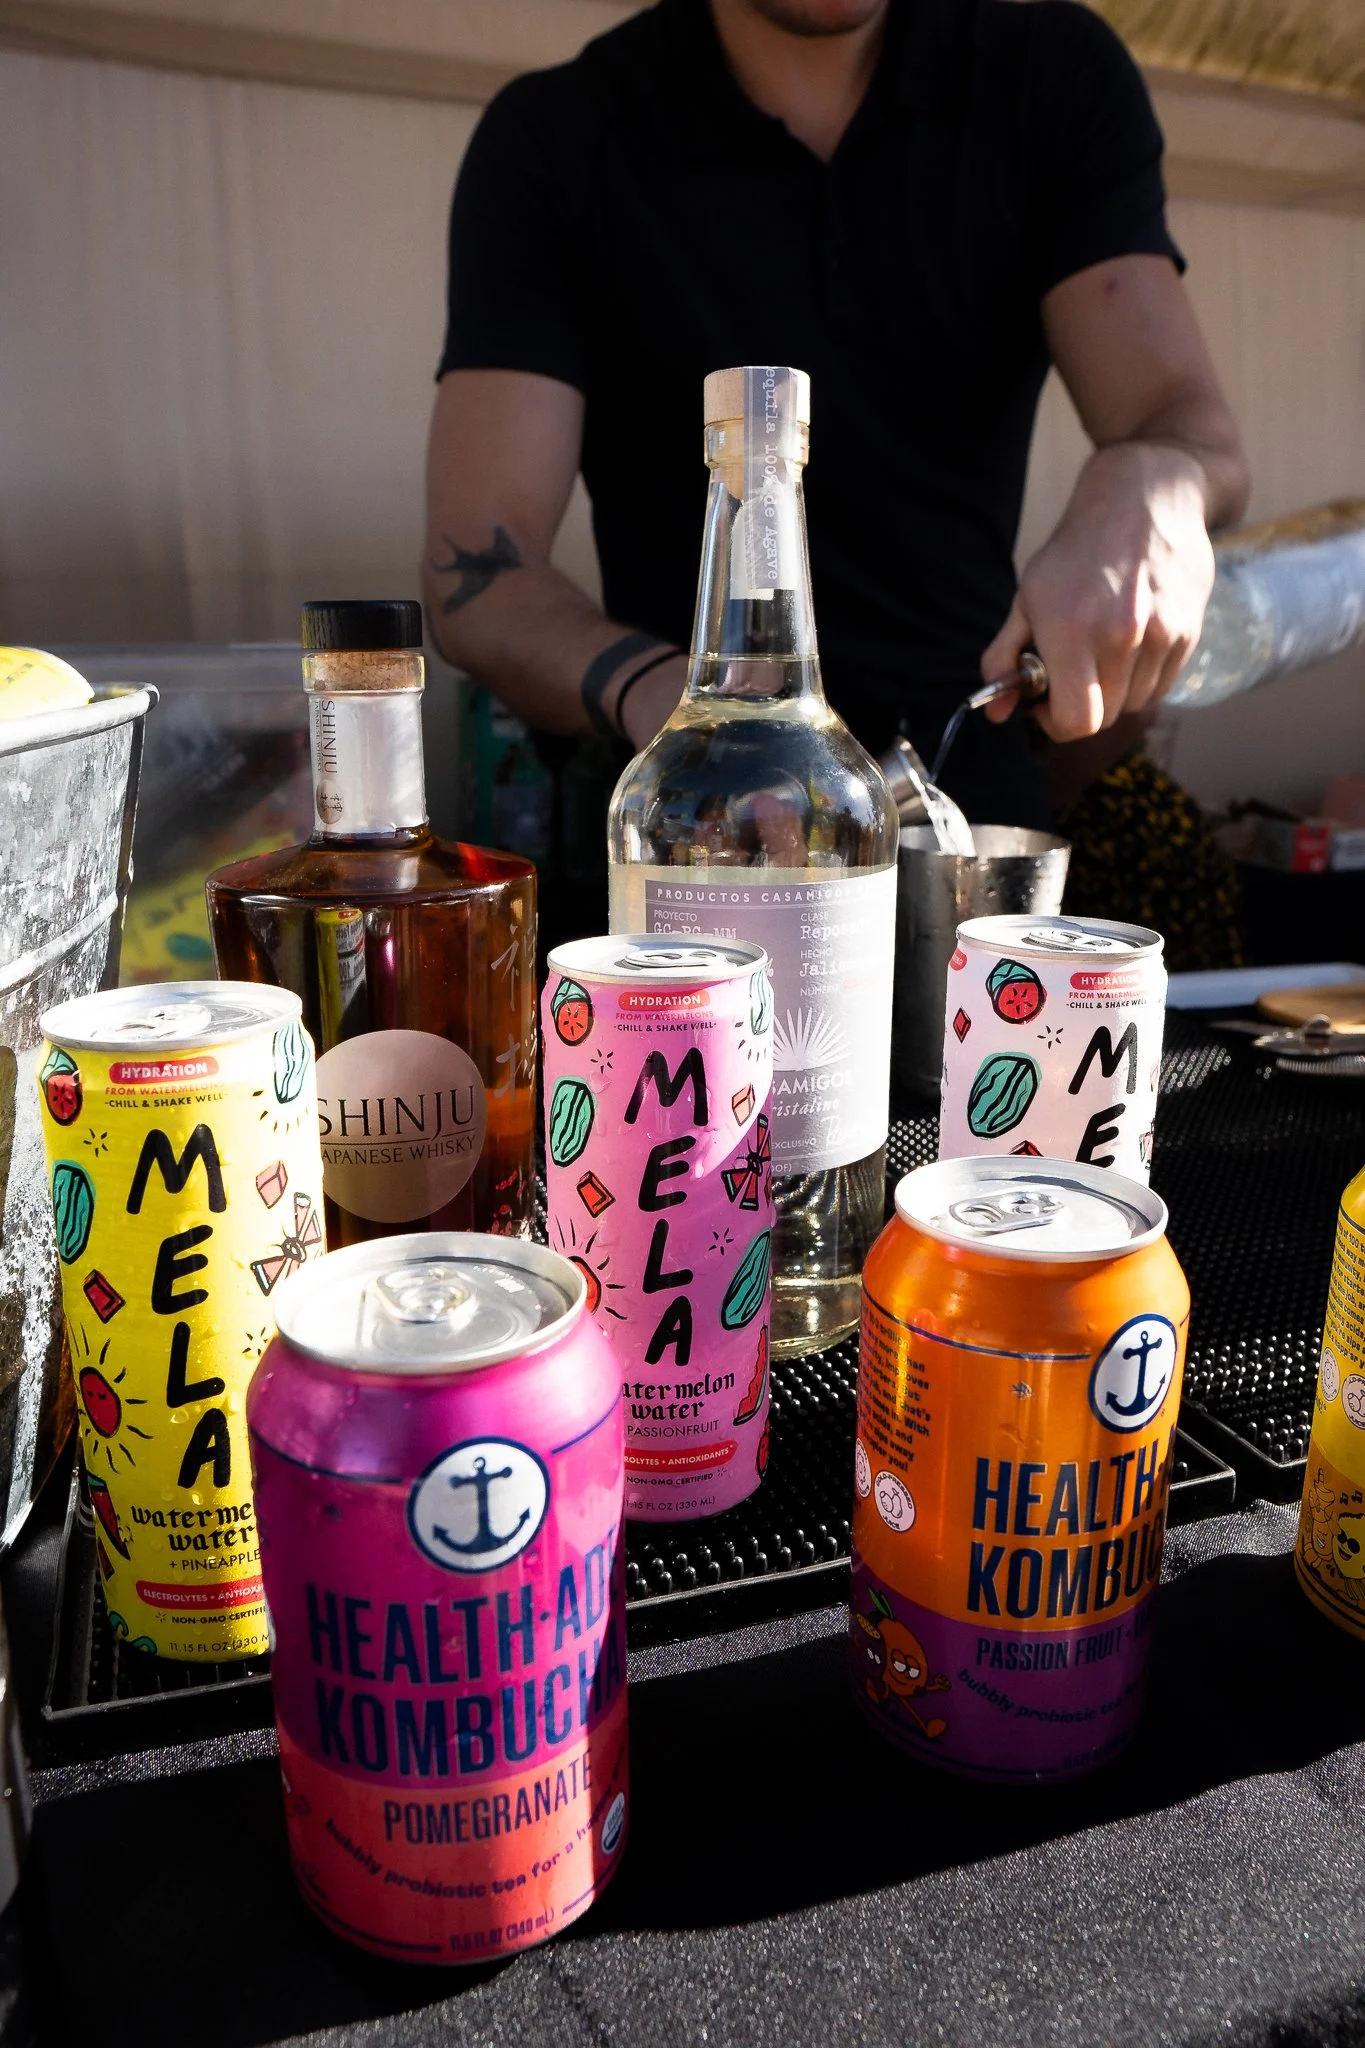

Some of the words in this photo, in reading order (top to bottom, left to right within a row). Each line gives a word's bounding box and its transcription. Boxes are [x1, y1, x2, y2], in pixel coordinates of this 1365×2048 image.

[765, 495, 777, 518] de
[763, 526, 778, 580] Agave
[322, 700, 337, 773] SHINJU
[657, 888, 751, 903] PRODUCTOS
[654, 909, 698, 922] PROYECTO
[629, 995, 701, 1006] HYDRATION
[1069, 991, 1095, 999] FROM
[1096, 1001, 1103, 1009] &
[1105, 1000, 1129, 1008] SHAKE
[615, 1012, 642, 1021] FROM
[645, 1011, 714, 1021] WATERMELONS
[646, 1024, 653, 1032] &
[656, 1023, 688, 1032] SHAKE
[121, 1062, 209, 1078] HYDRATION
[105, 1087, 136, 1096] FROM
[154, 1097, 192, 1107] SHAKE
[318, 1085, 475, 1141] SHINJU
[408, 1134, 477, 1161] WHISKY
[1344, 1304, 1364, 1326] comes
[1346, 1334, 1361, 1351] sips
[631, 1402, 704, 1420] water
[627, 1420, 719, 1437] PASSIONFRUIT
[627, 1476, 673, 1485] NON-GMO
[675, 1473, 713, 1485] CERTIFIED
[646, 1502, 656, 1511] FL
[658, 1501, 672, 1511] OZ
[675, 1499, 697, 1511] (330
[700, 1496, 715, 1506] ML)
[168, 1525, 255, 1551] water
[143, 1588, 208, 1602] ELECTROLYTES
[171, 1615, 226, 1625] NON-GMO
[170, 1642, 194, 1653] 11.15
[198, 1643, 208, 1653] FL
[211, 1641, 228, 1652] OZ
[231, 1636, 259, 1651] (330
[976, 1637, 1069, 1671] PASSION
[1075, 1623, 1125, 1666] FRUIT
[957, 1668, 1014, 1713] bubbly
[1014, 1704, 1096, 1724] probiotic
[383, 1747, 593, 1846] POMEGRANATE
[325, 1818, 382, 1876] bubbly
[384, 1870, 486, 1899] probiotic
[491, 1874, 527, 1895] tea
[530, 1854, 561, 1878] for
[565, 1842, 574, 1854] a
